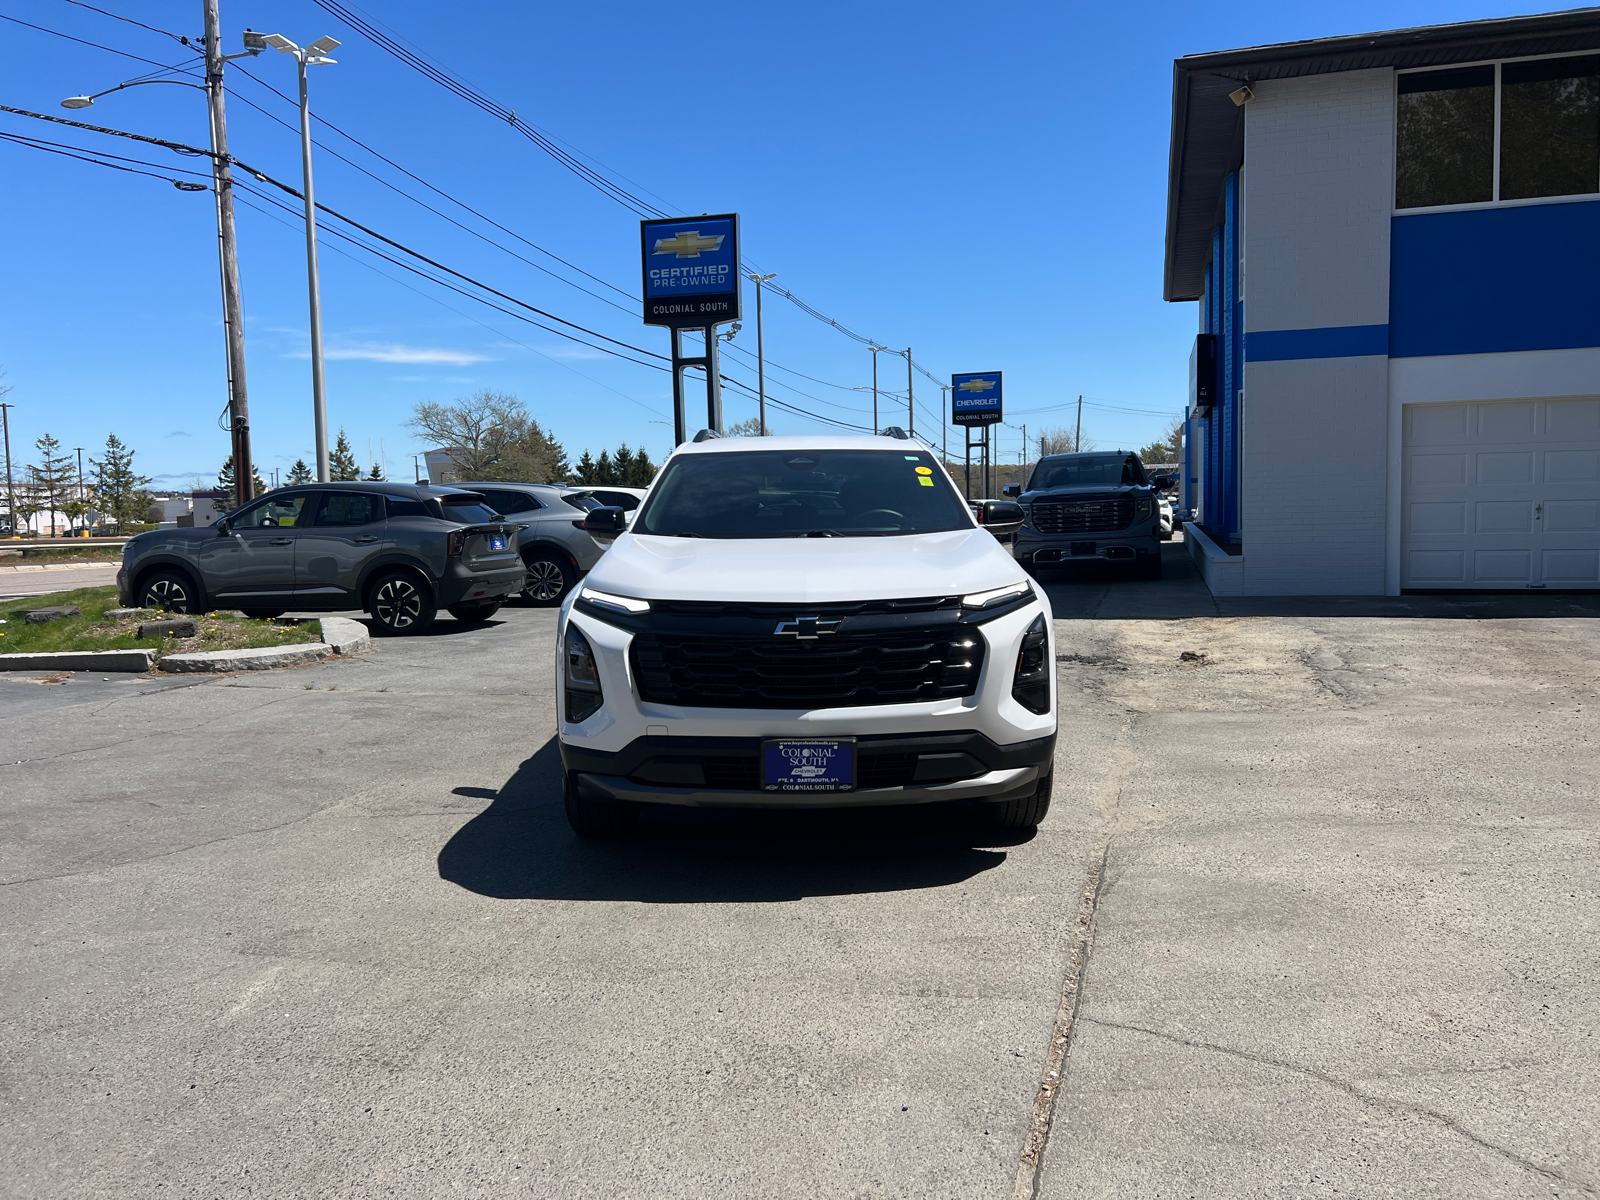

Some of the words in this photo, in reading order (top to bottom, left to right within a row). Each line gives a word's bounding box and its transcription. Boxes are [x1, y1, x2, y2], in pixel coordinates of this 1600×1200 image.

[650, 264, 728, 278] CERTIFIED
[654, 275, 725, 287] PRE-OWNED
[653, 304, 695, 314] COLONIAL
[700, 302, 728, 311] SOUTH
[956, 398, 998, 406] CHEVROLET
[781, 748, 836, 757] COLONIAL
[790, 757, 827, 766] SOUTH
